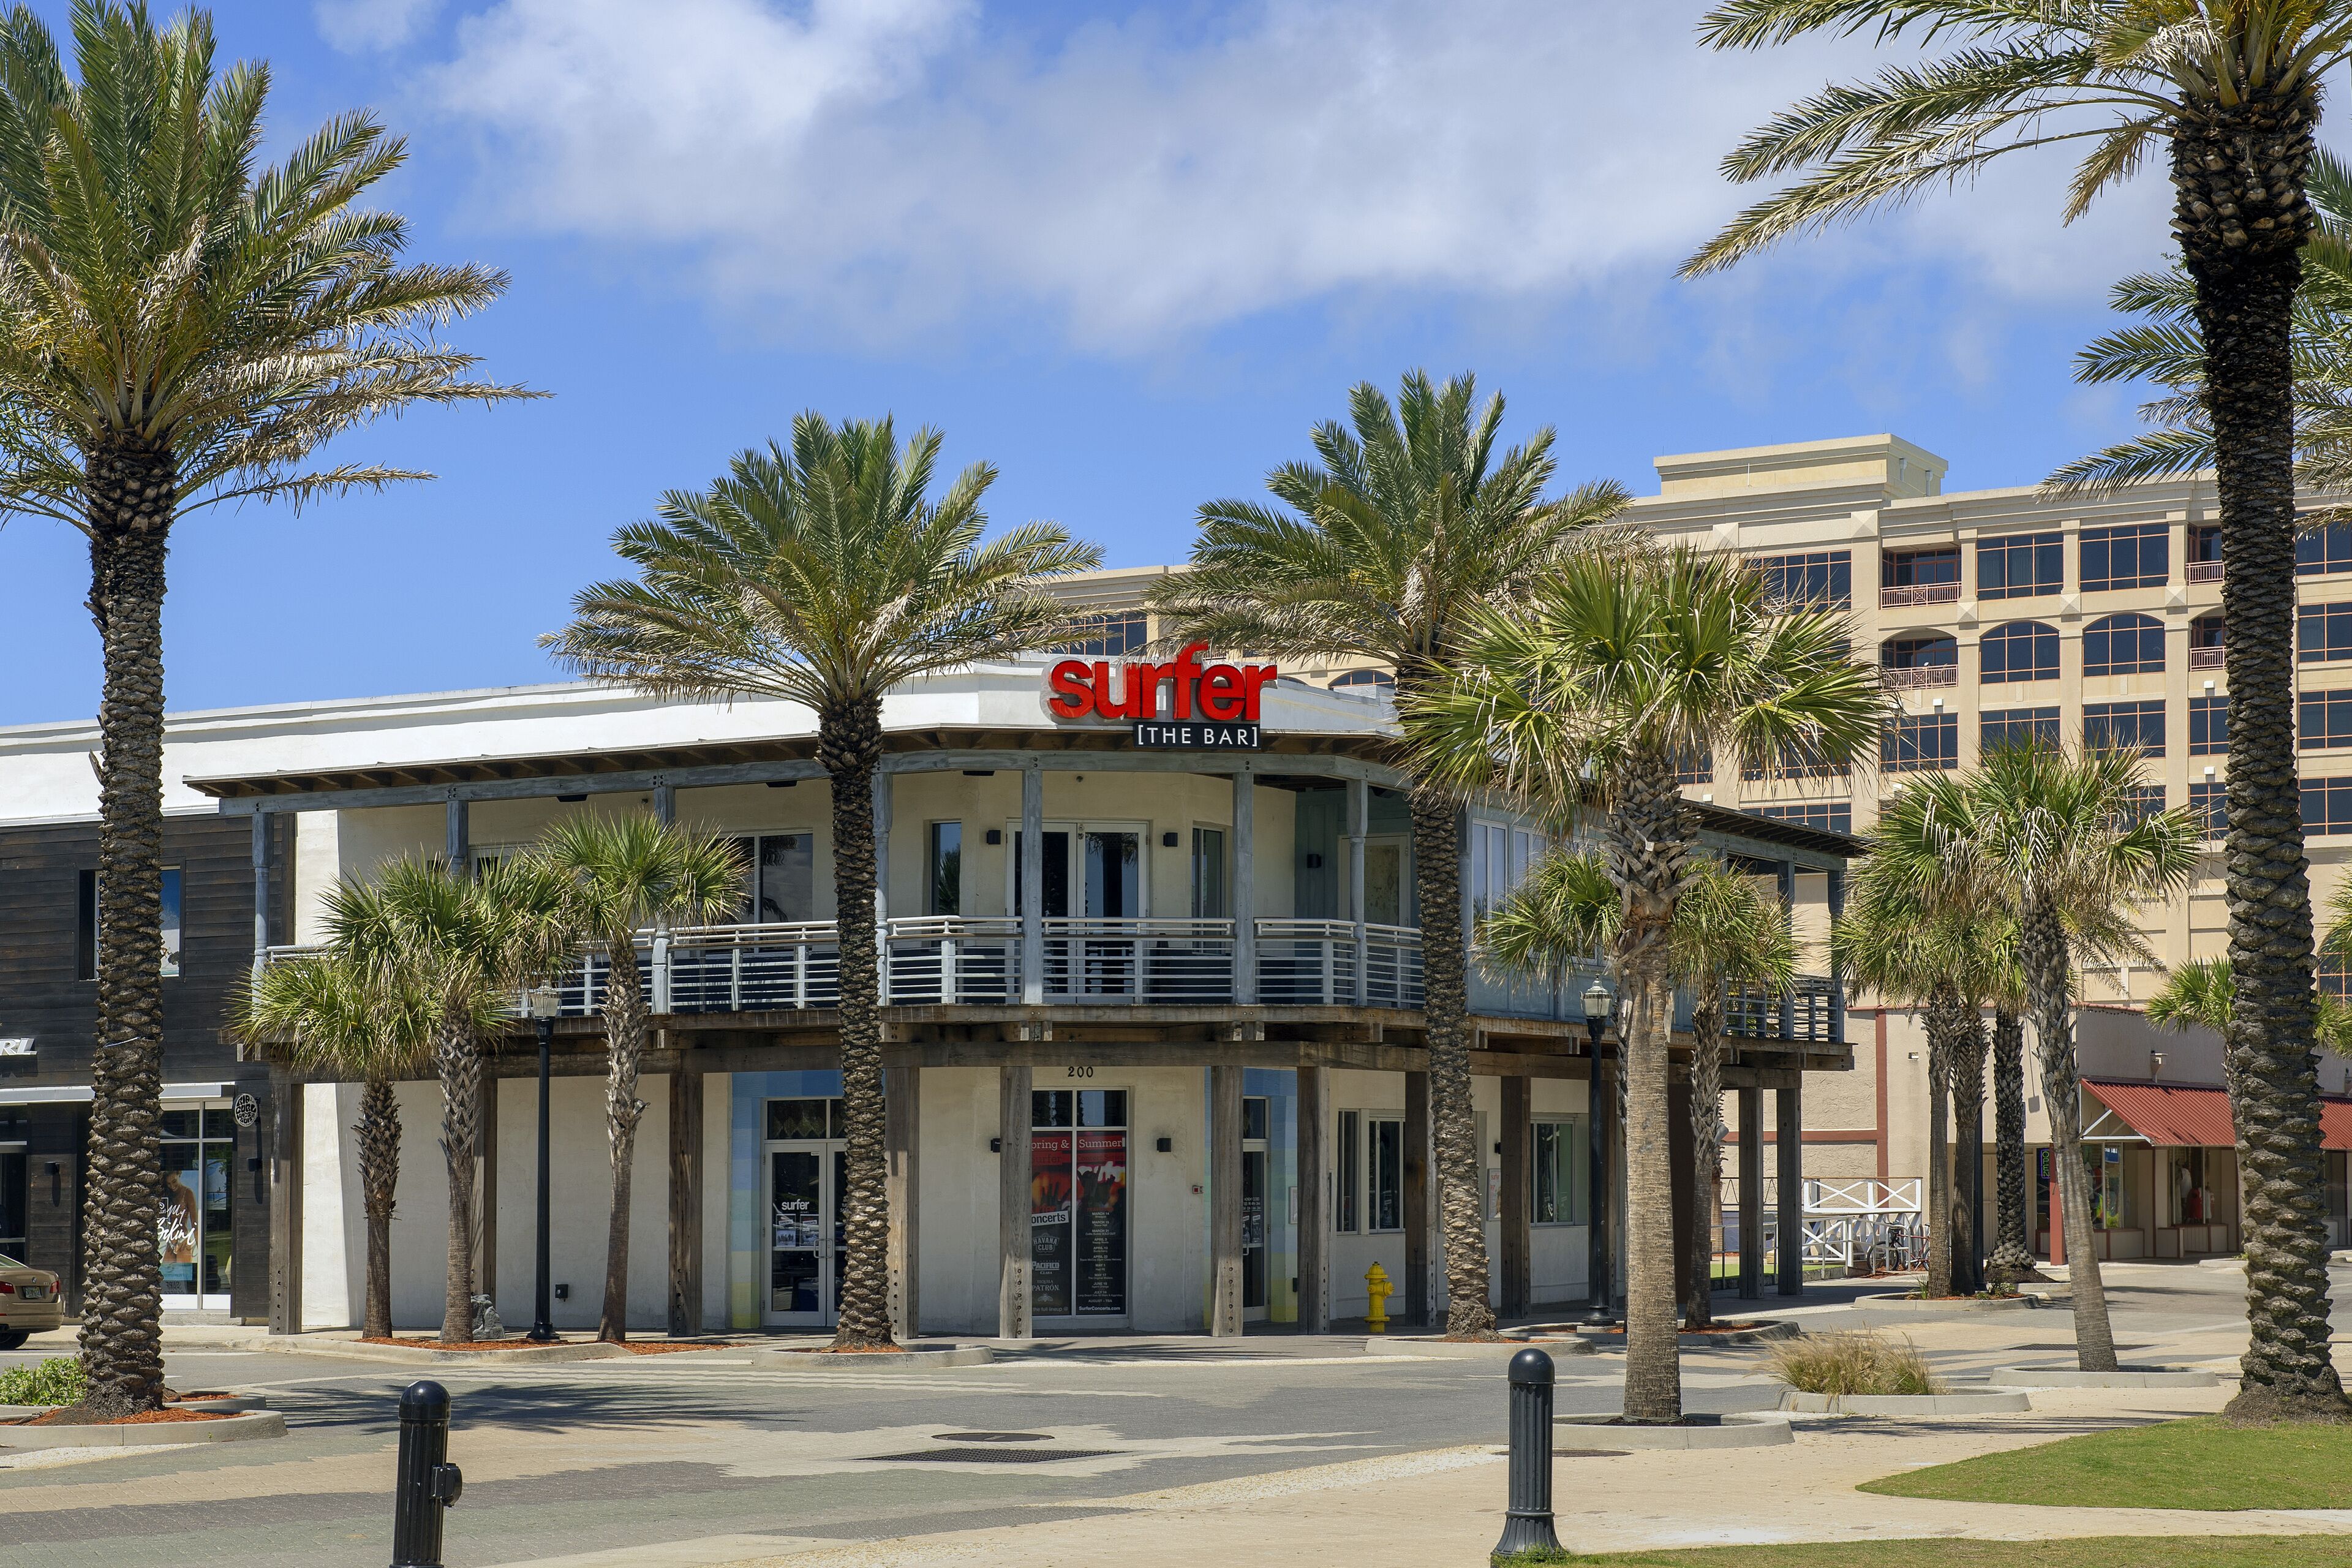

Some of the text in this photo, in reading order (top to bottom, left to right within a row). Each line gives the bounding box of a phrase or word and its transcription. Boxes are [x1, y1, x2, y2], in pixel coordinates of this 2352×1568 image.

[1047, 638, 1278, 721] surfer
[1068, 1066, 1094, 1078] 200
[236, 1095, 250, 1107] RIP
[1031, 1139, 1122, 1151] pring & Summer
[782, 1199, 810, 1210] surfer
[167, 1204, 186, 1224] My
[1031, 1213, 1066, 1224] oncerts
[157, 1218, 197, 1245] Bikini
